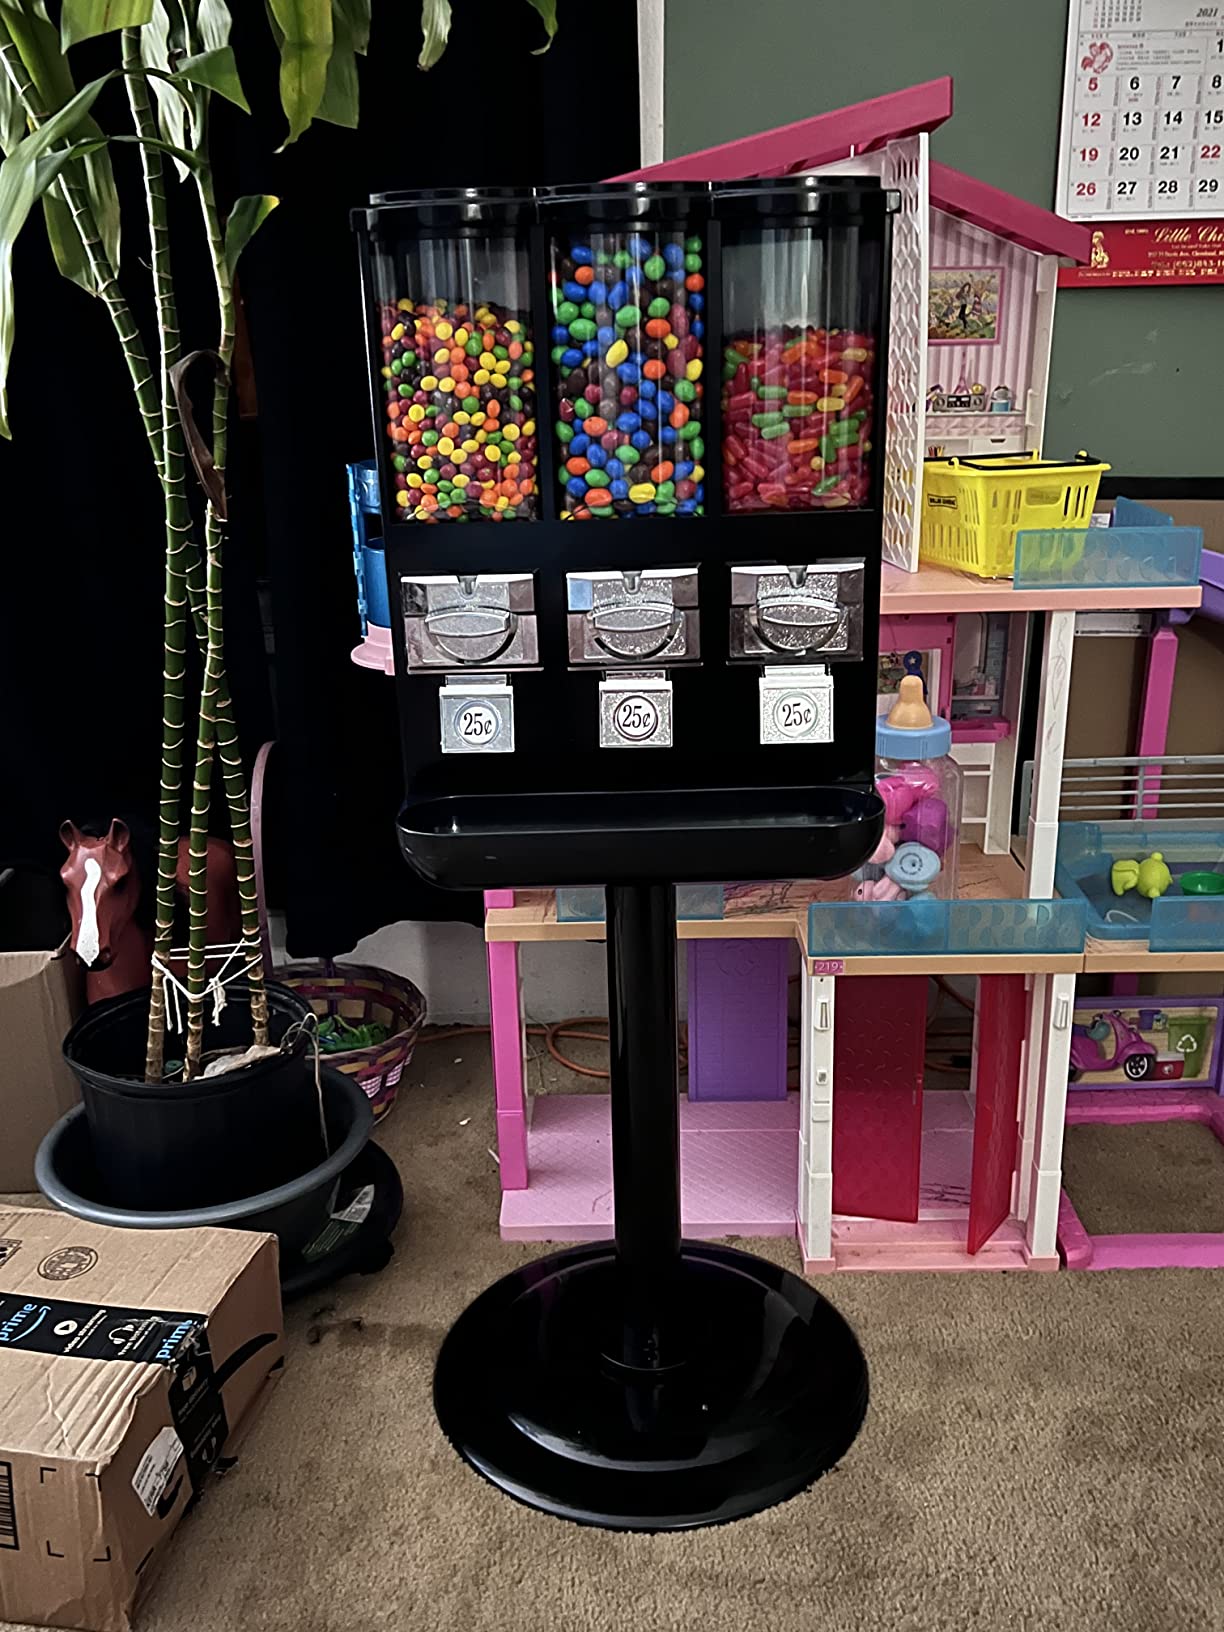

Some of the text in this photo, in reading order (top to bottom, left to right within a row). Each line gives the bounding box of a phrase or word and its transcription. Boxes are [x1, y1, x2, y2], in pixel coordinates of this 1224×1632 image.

[1196, 7, 1219, 17] 2021
[1217, 38, 1224, 54] 1
[1088, 75, 1222, 91] 5 6 7 8
[1082, 110, 1224, 127] 12 13 14 15
[1080, 145, 1221, 161] 19 20 21 22
[1076, 179, 1218, 196] 26 27 28 29
[1153, 227, 1192, 243] Little
[1197, 226, 1224, 243] Chi
[622, 704, 651, 728] 25¢
[782, 702, 812, 727] 25¢
[463, 712, 493, 736] 25¢
[819, 961, 839, 972] 219
[0, 1303, 38, 1342] prime
